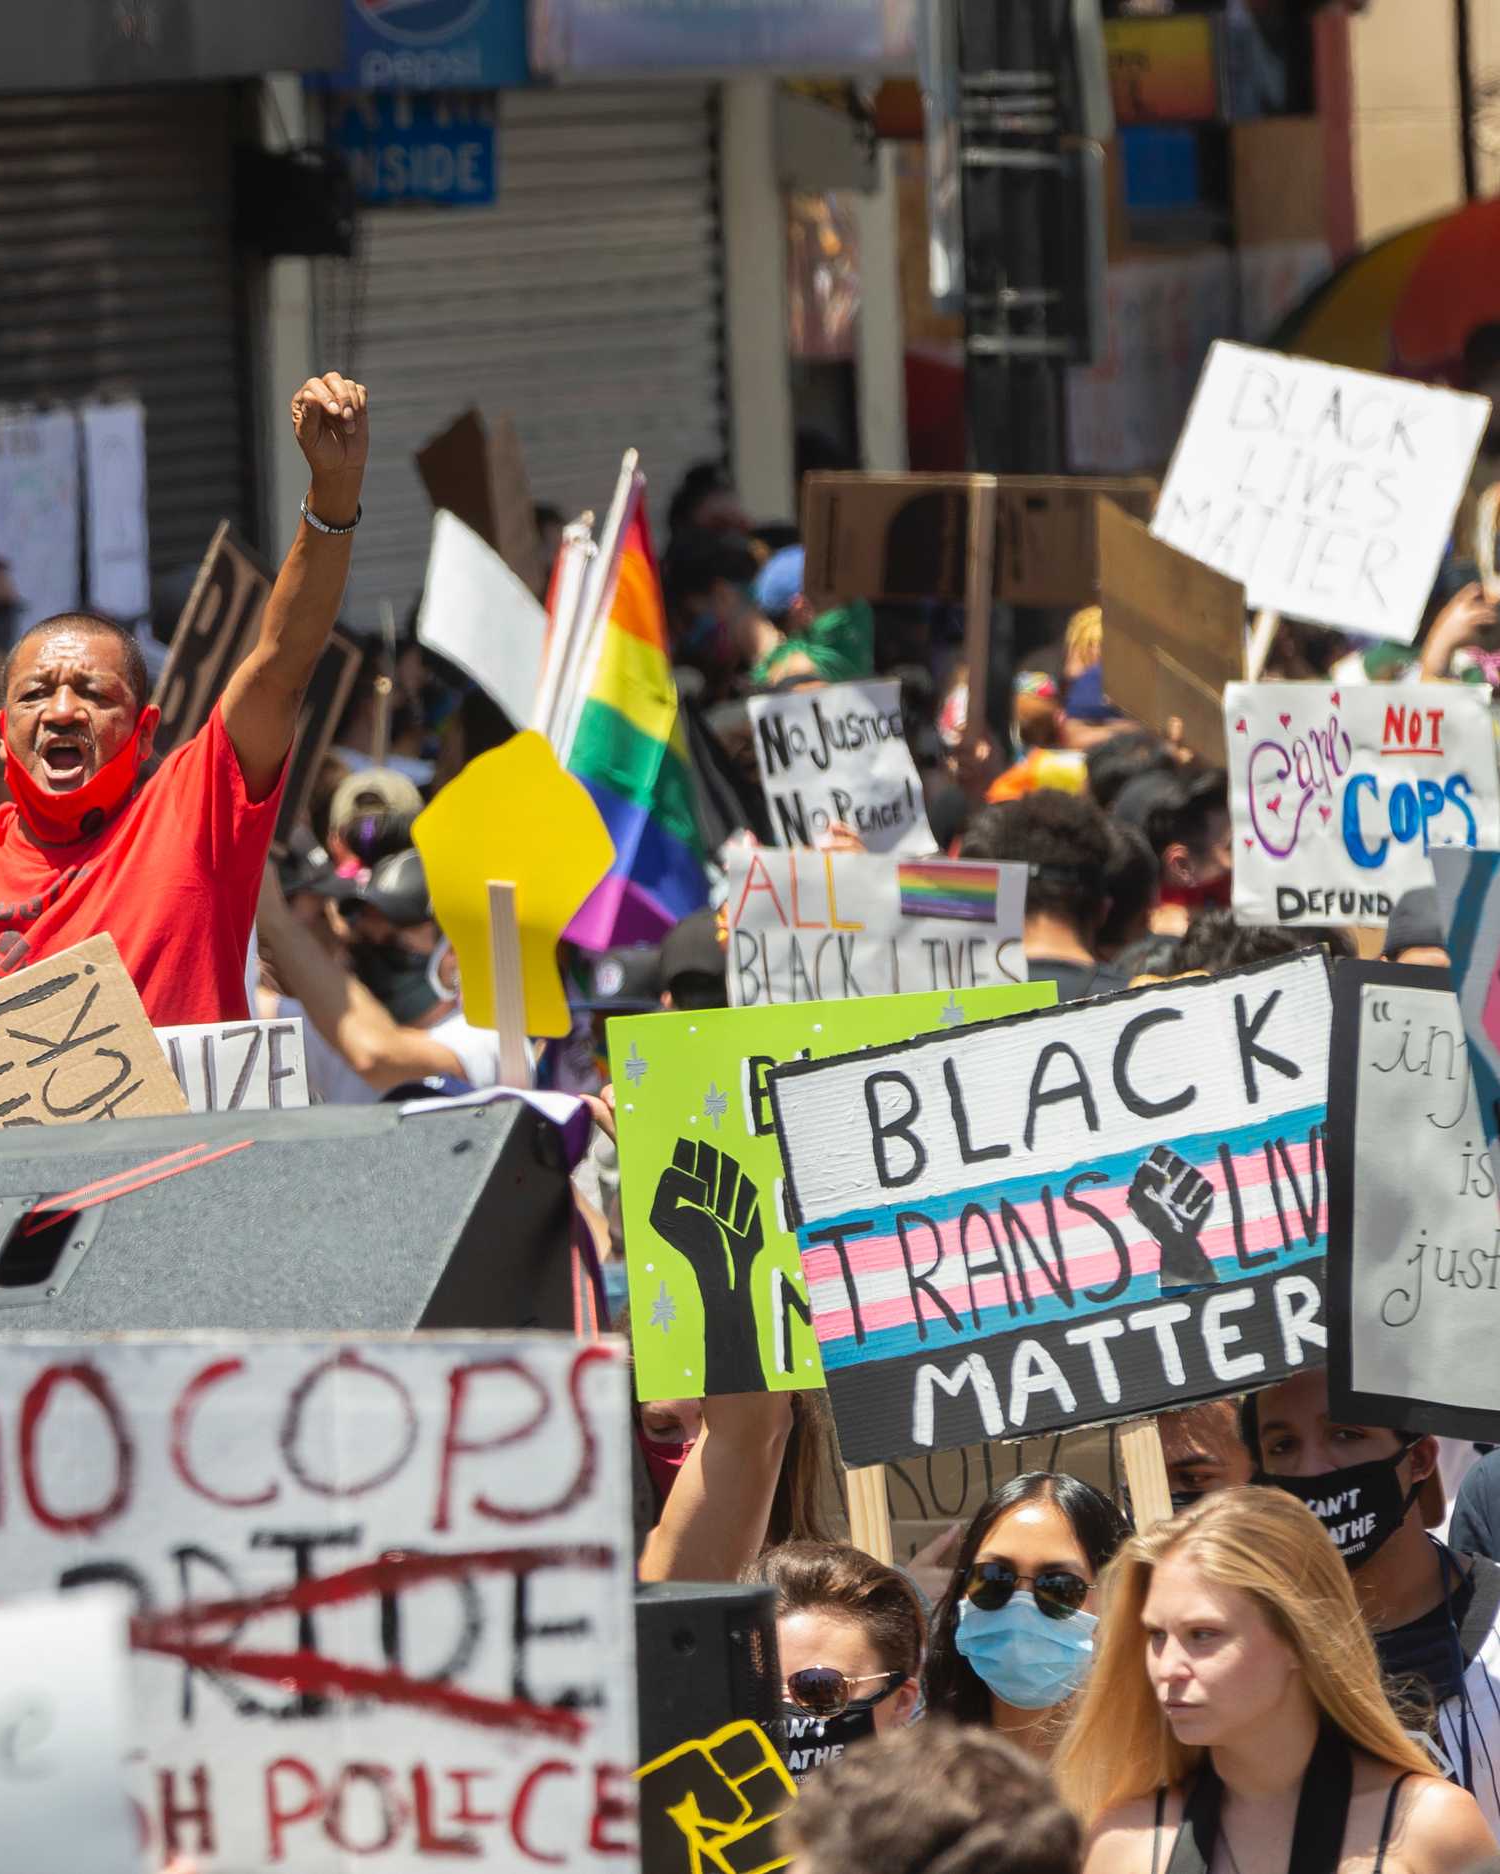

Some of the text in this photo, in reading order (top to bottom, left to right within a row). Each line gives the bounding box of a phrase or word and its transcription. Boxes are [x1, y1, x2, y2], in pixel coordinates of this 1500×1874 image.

[361, 49, 482, 89] pepsi
[352, 142, 485, 193] NSIDE
[1228, 363, 1427, 461] BLACK
[1235, 447, 1403, 528] LIVES
[1160, 495, 1388, 608] MATTER
[1383, 703, 1445, 757] NOT
[1342, 772, 1478, 870] COPS
[734, 852, 864, 932] ALL
[1276, 886, 1393, 923] DEFUND
[733, 928, 865, 1006] BLACK
[864, 989, 1302, 1189] BLACK
[1459, 1141, 1495, 1198] is
[806, 1170, 1132, 1346] TRANS
[1218, 1122, 1328, 1270] LIV
[911, 1274, 1328, 1447] MATTER
[170, 1344, 617, 1535] COPS
[1328, 1512, 1377, 1545] ATHE
[787, 1744, 845, 1771] ATHE
[267, 1754, 639, 1863] POLICE
